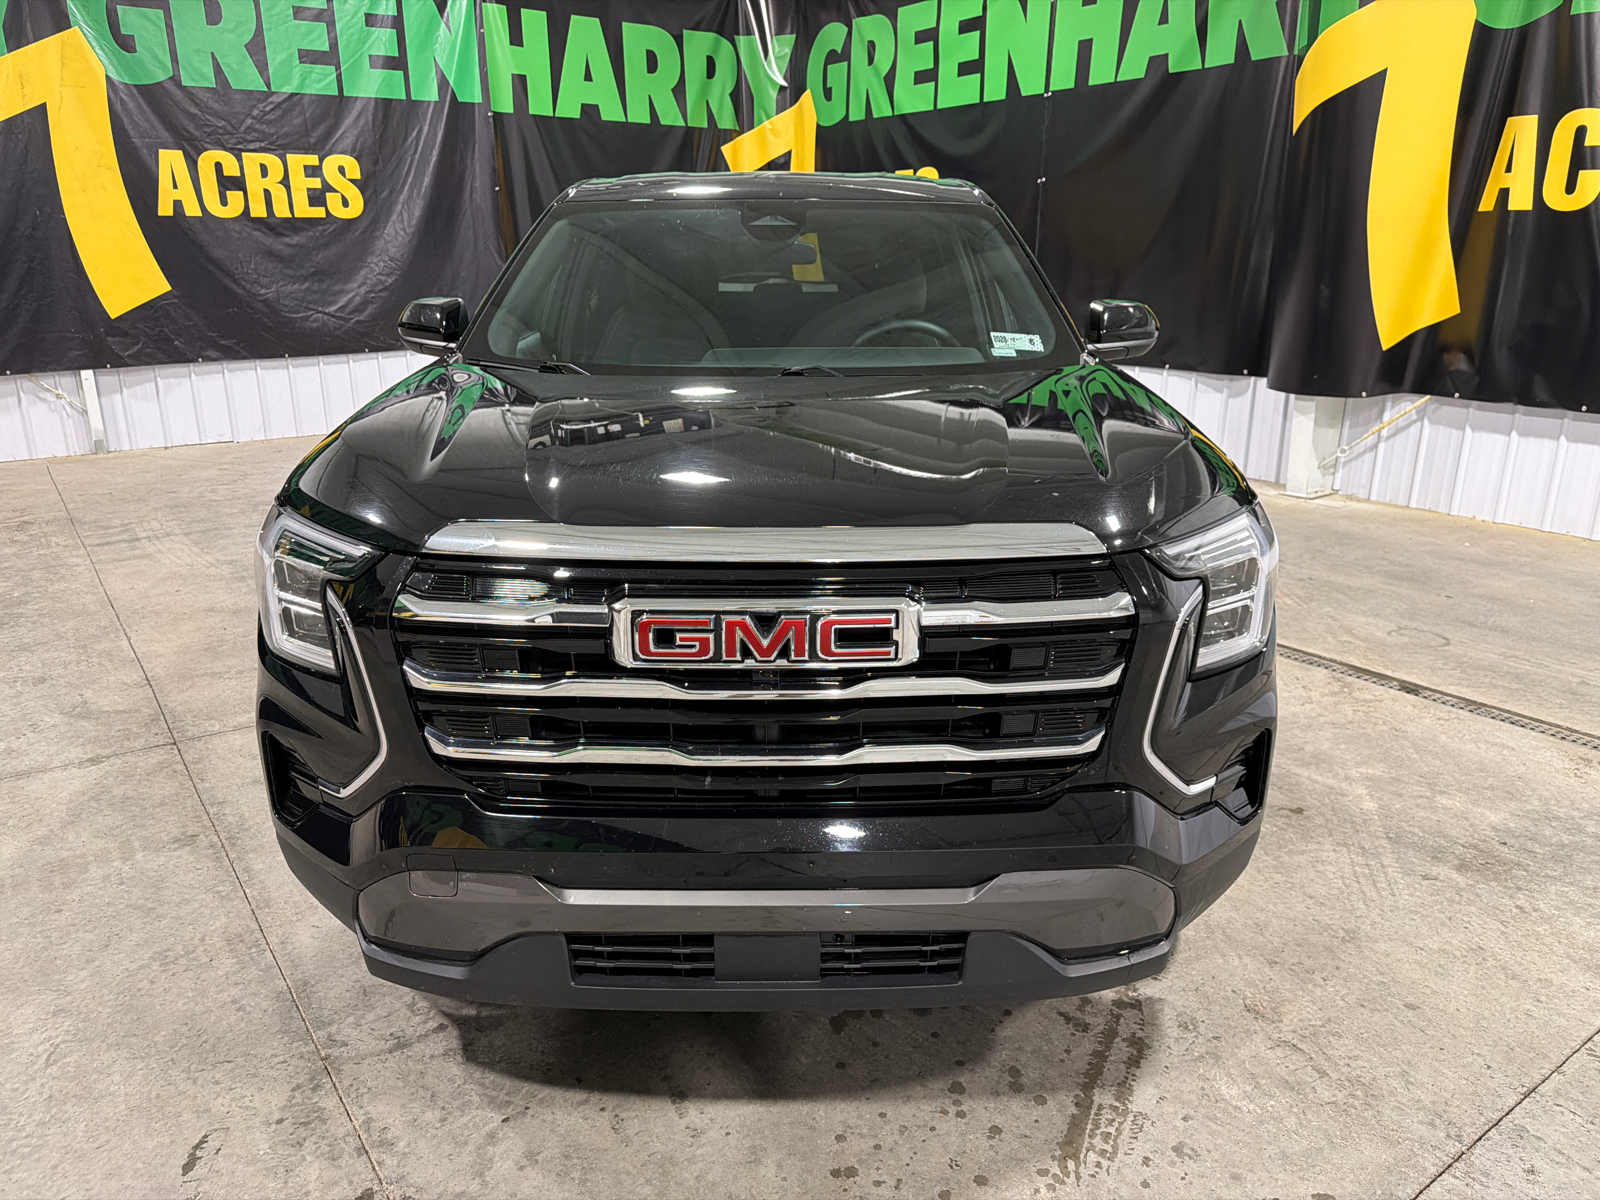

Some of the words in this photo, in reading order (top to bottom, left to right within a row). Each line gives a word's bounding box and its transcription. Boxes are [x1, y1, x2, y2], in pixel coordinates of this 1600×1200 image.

[67, 0, 484, 103] GREEN
[482, 2, 797, 130] HARRY
[807, 0, 1051, 127] GREEN
[0, 26, 172, 319] 7
[156, 148, 364, 219] ACRES
[1293, 0, 1478, 351] 7
[635, 611, 897, 662] GMC
